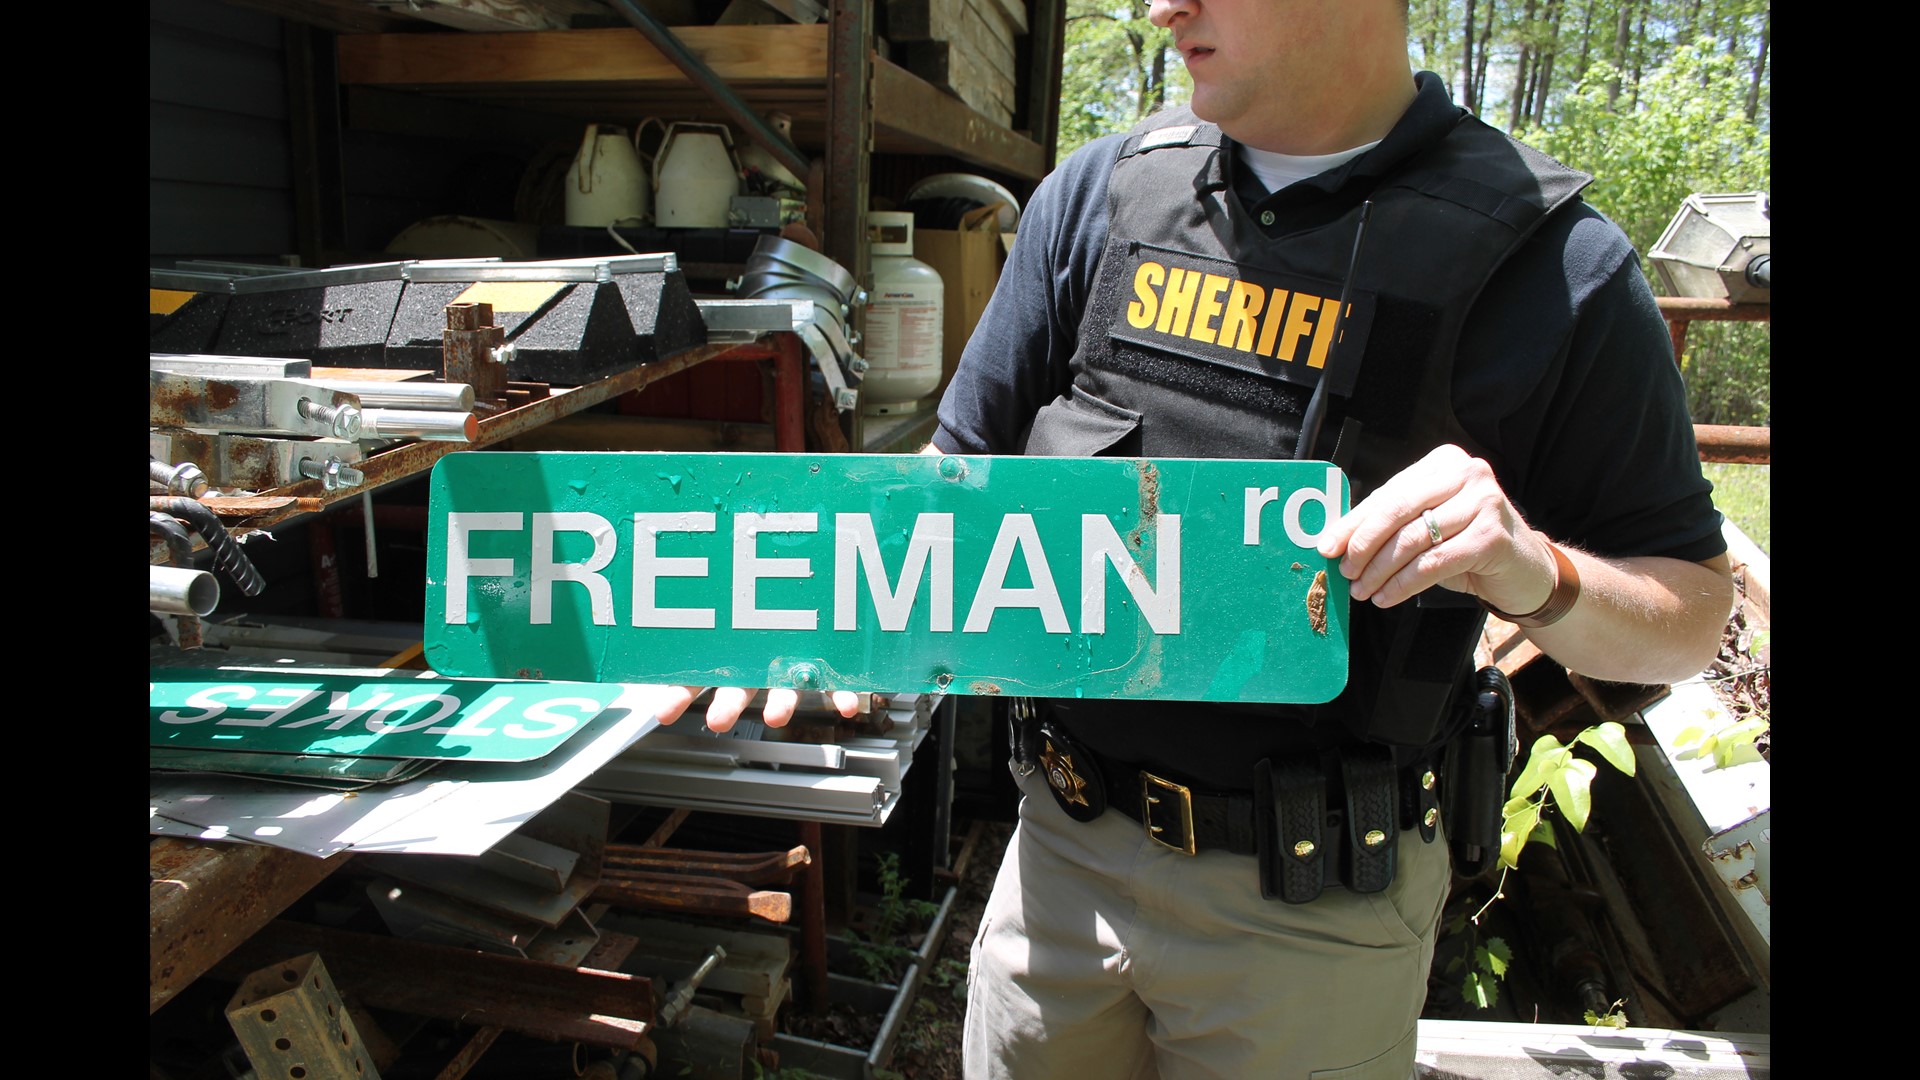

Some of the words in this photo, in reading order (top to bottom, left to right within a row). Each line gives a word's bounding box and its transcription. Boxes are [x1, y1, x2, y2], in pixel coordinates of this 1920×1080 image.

[1127, 261, 1351, 369] SHERIFF
[445, 511, 1181, 635] FREEMAN
[1243, 466, 1342, 549] rd
[159, 684, 601, 740] STOKES
